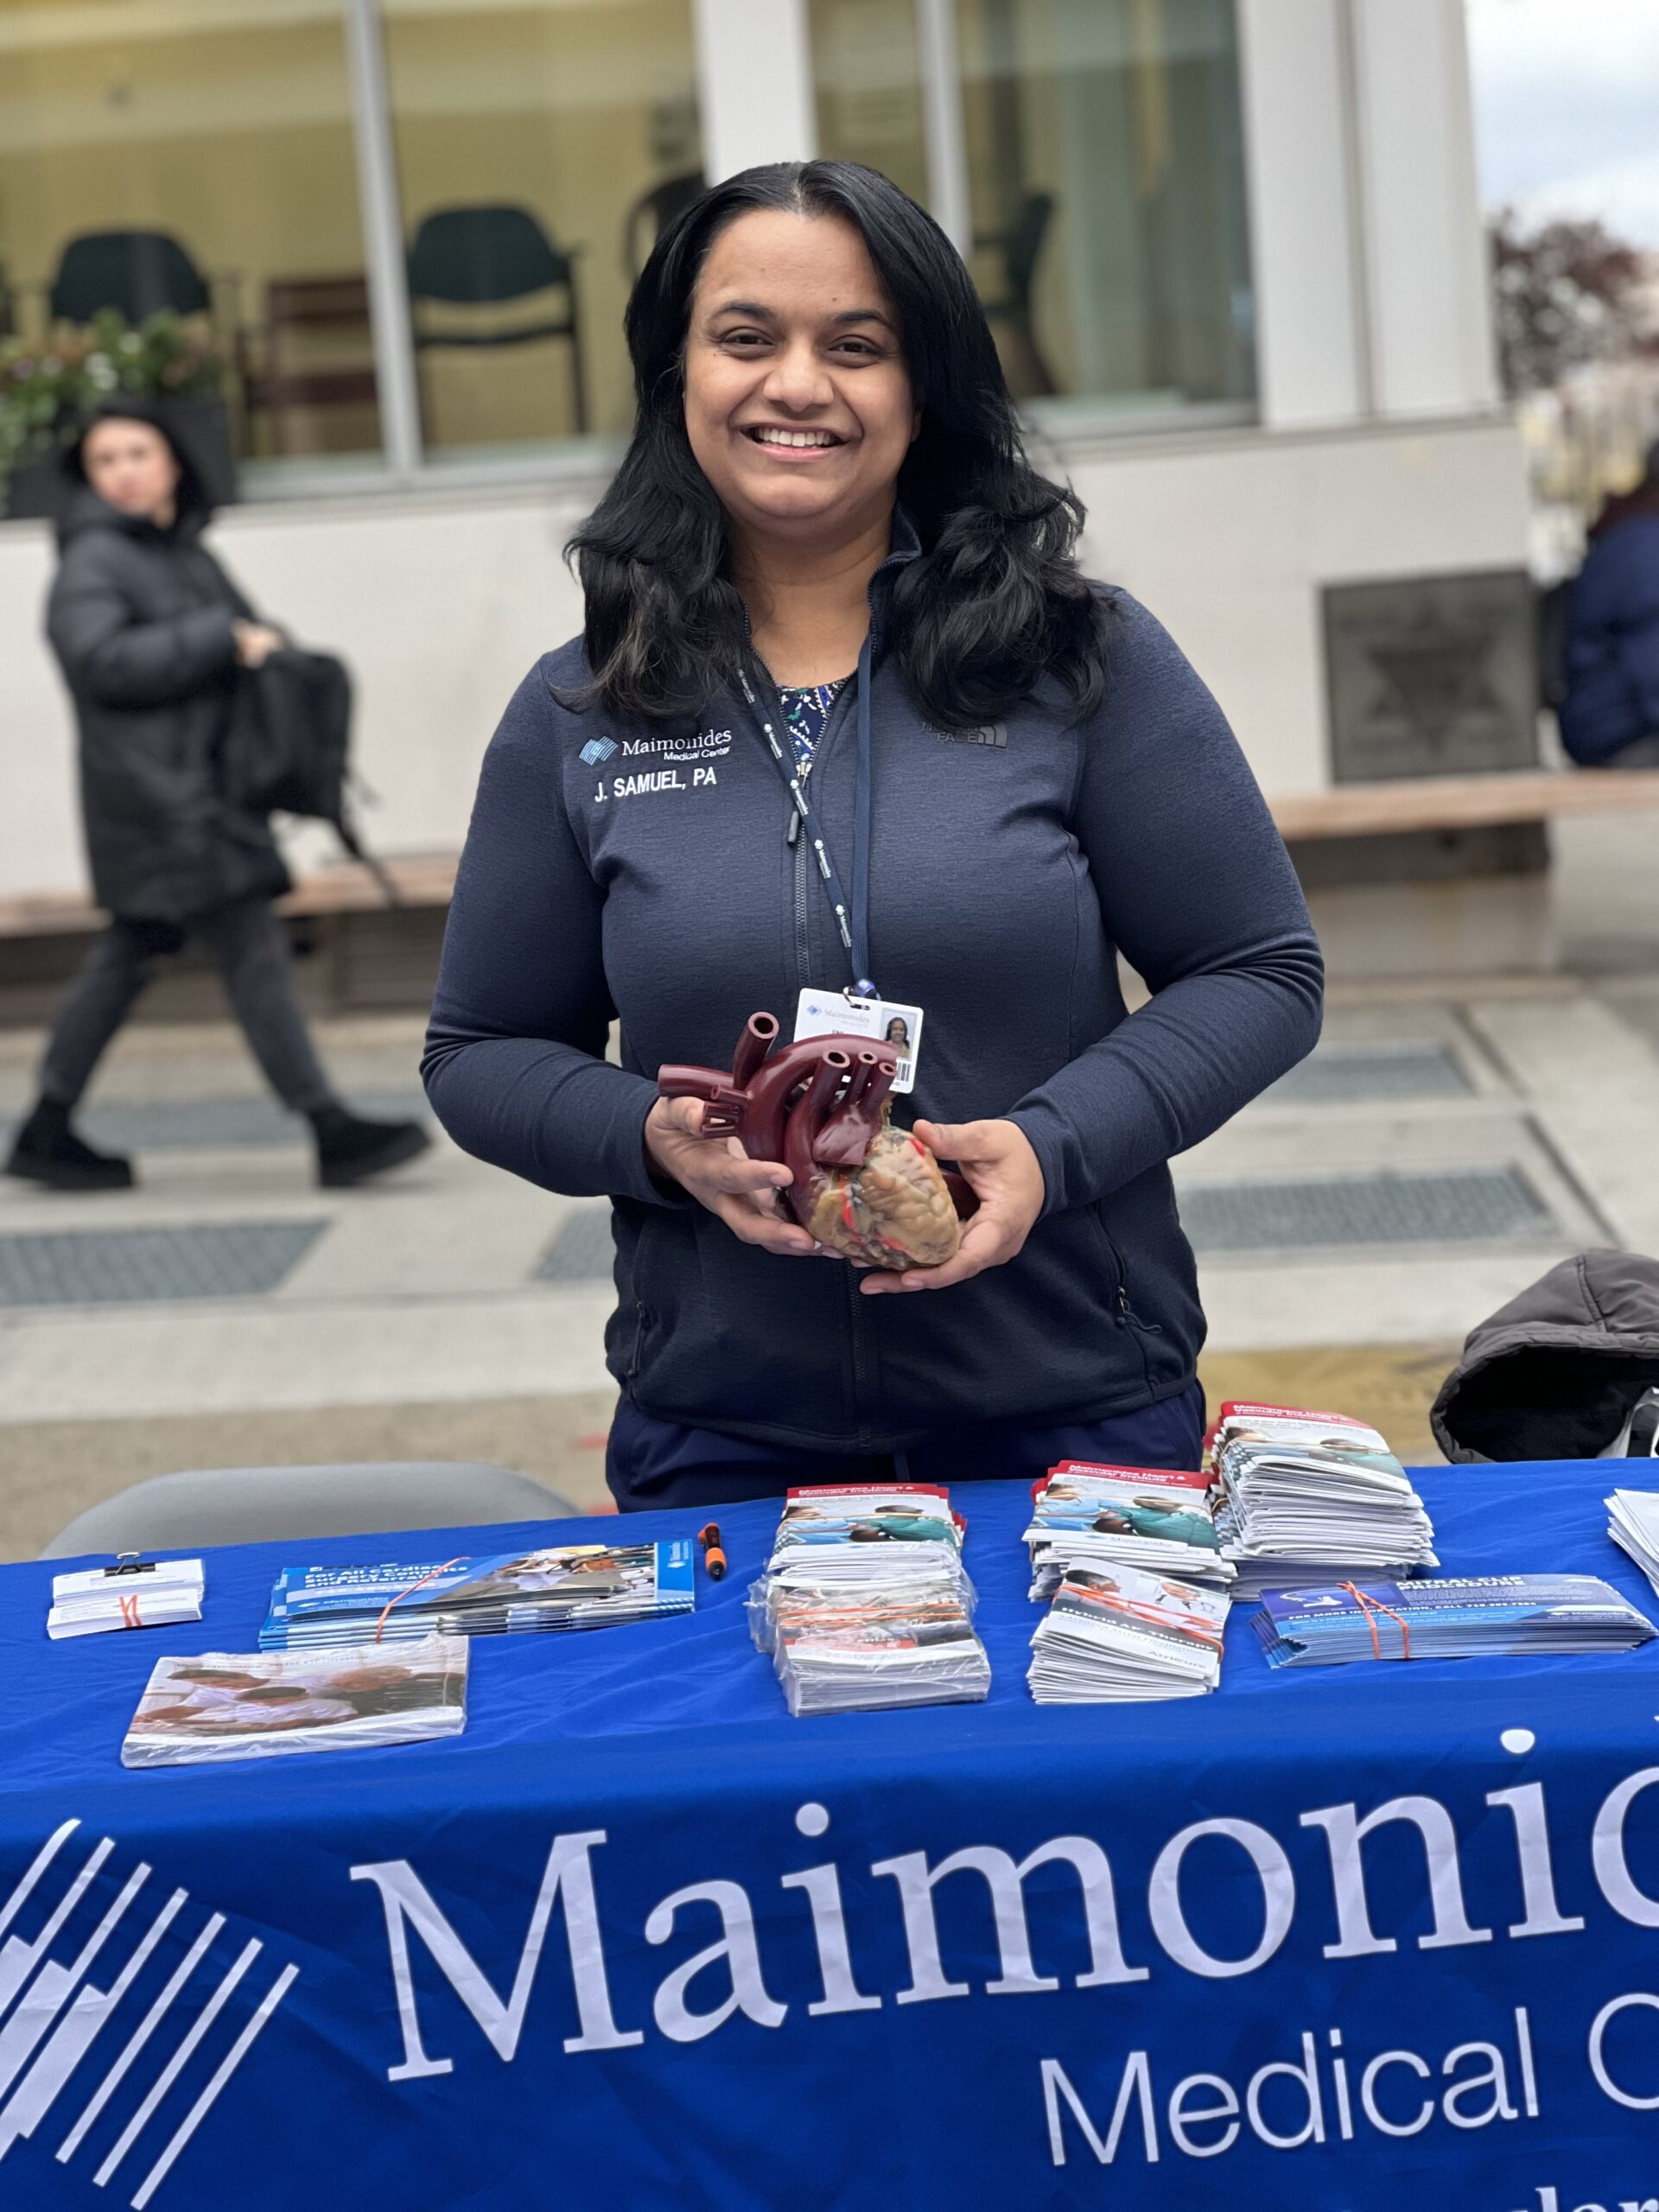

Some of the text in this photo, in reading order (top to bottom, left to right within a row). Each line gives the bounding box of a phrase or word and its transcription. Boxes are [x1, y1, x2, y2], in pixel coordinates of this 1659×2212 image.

[621, 728, 733, 756] Maimonides
[937, 731, 978, 745] FACE
[663, 746, 732, 761] Medical Center
[594, 766, 717, 803] J. SAMUEL, PA
[369, 1564, 443, 1574] Cardiac
[305, 1573, 379, 1584] Surgery
[1396, 1577, 1473, 1586] MITRAL
[1398, 1580, 1527, 1591] PROCEDURE
[1061, 1606, 1117, 1624] Hybrid
[1147, 1629, 1215, 1651] Therapy
[1040, 2006, 1540, 2166] Medical
